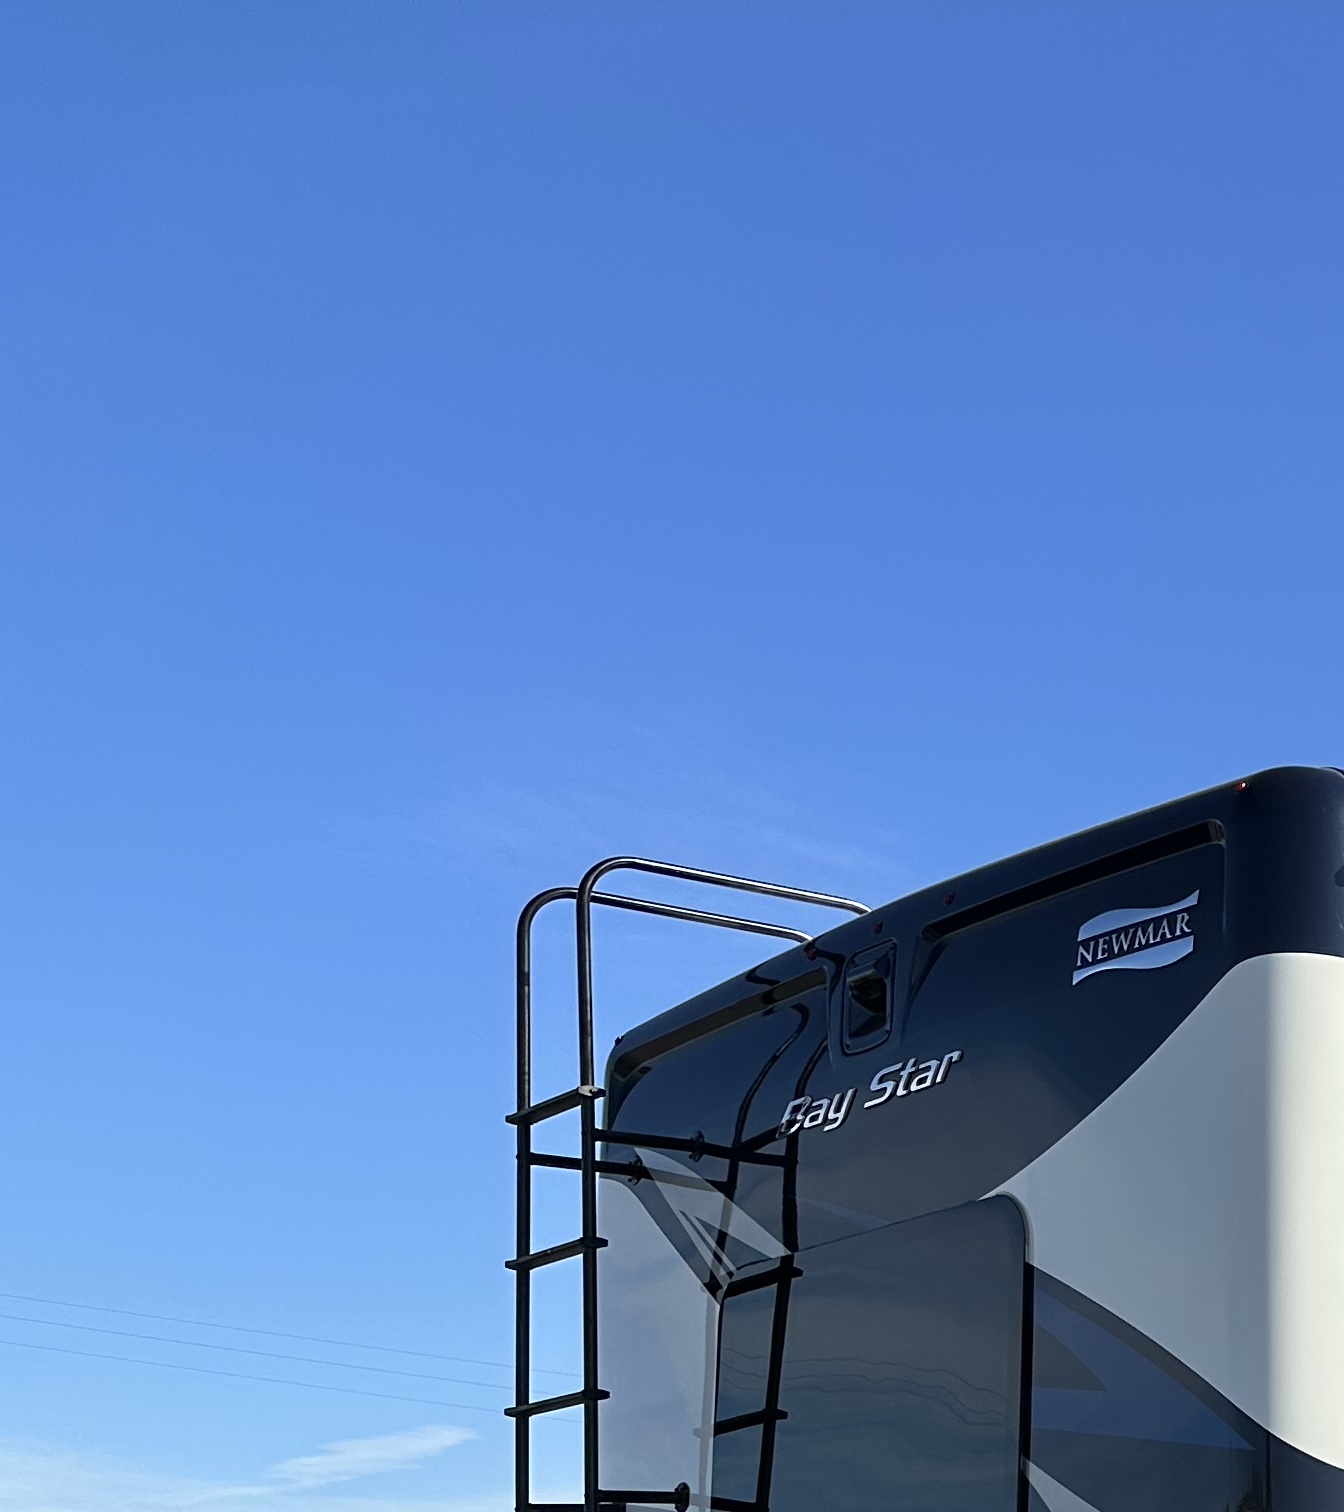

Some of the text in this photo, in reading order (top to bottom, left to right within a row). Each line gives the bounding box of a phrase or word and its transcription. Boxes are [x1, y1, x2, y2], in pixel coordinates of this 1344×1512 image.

[1076, 912, 1192, 966] NEWMAR
[776, 1050, 963, 1139] Bay Star
